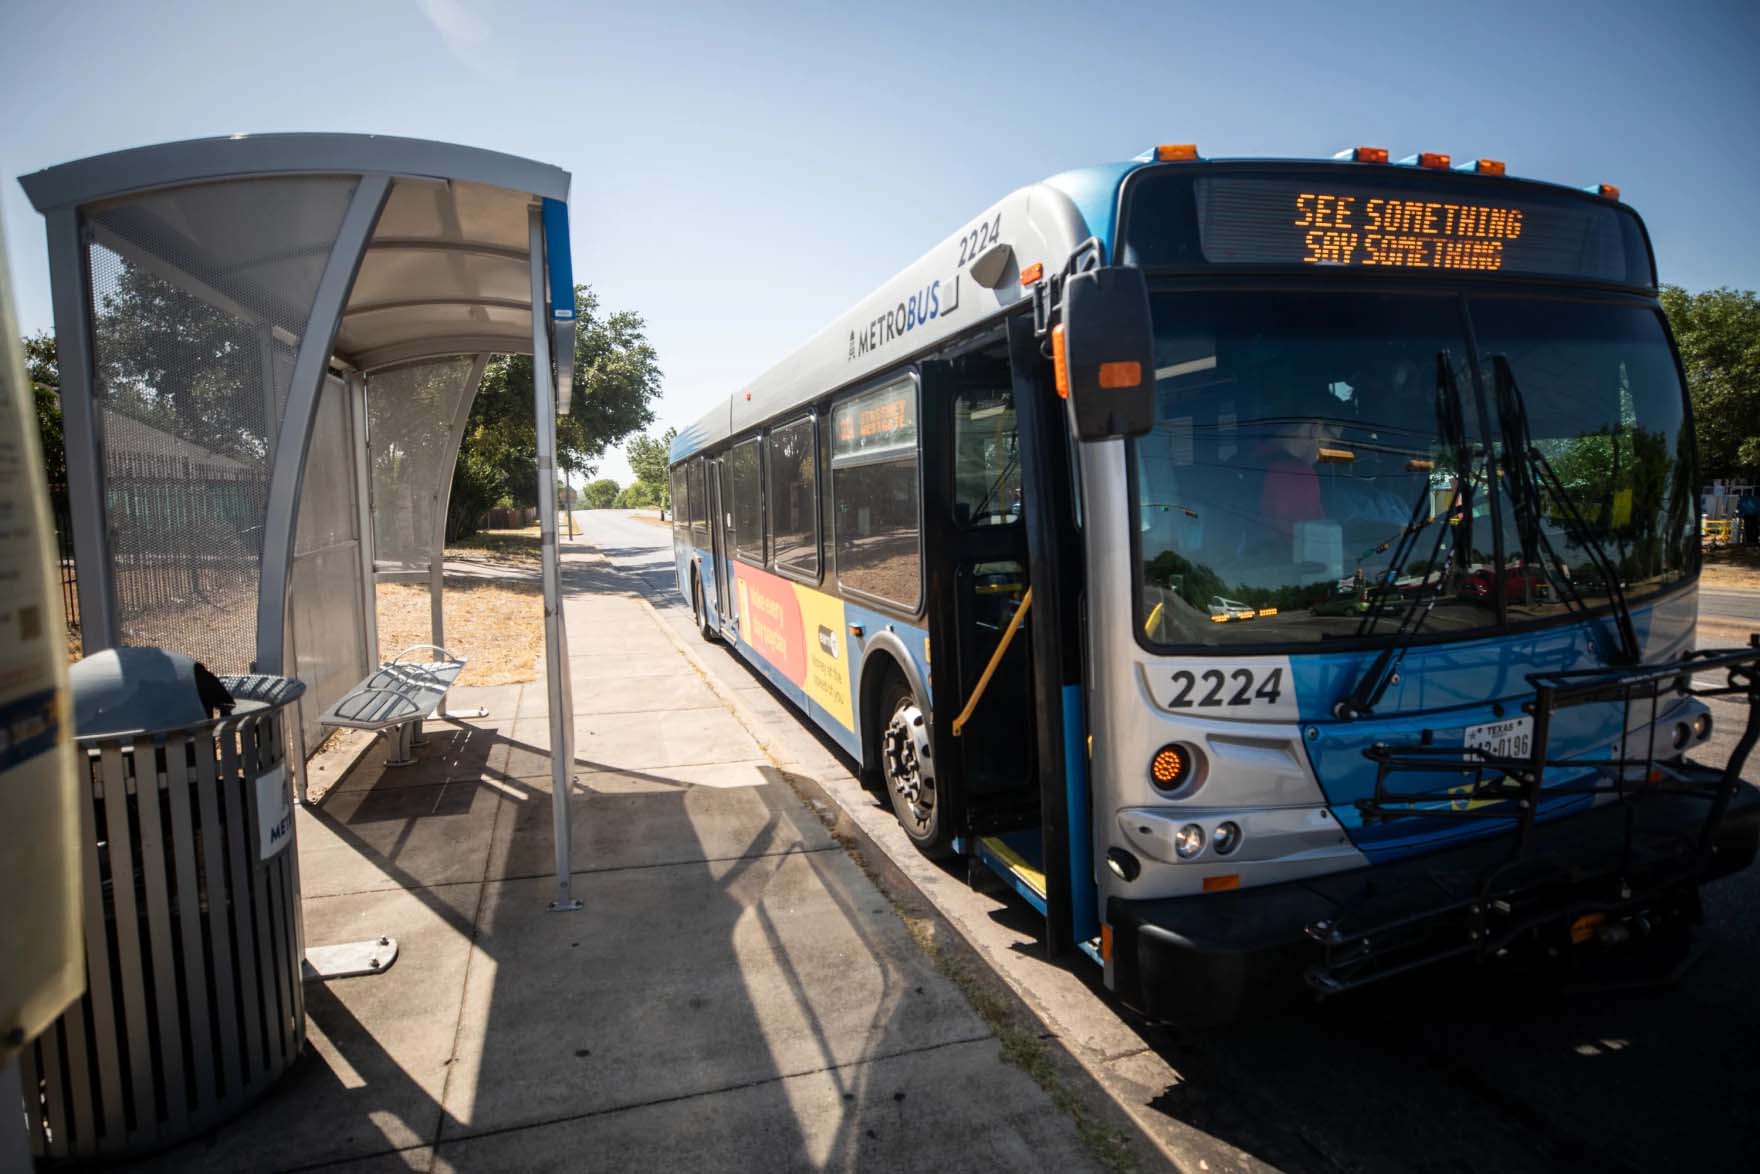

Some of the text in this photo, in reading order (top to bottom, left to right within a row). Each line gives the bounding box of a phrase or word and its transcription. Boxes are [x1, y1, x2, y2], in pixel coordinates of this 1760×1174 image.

[1295, 194, 1523, 239] SEE SOMETHING
[957, 212, 1002, 268] 2224
[1304, 231, 1504, 270] SAY SOMETHING
[858, 279, 940, 357] METROBUS
[1167, 667, 1283, 708] 2224
[1487, 722, 1514, 735] TEXAS
